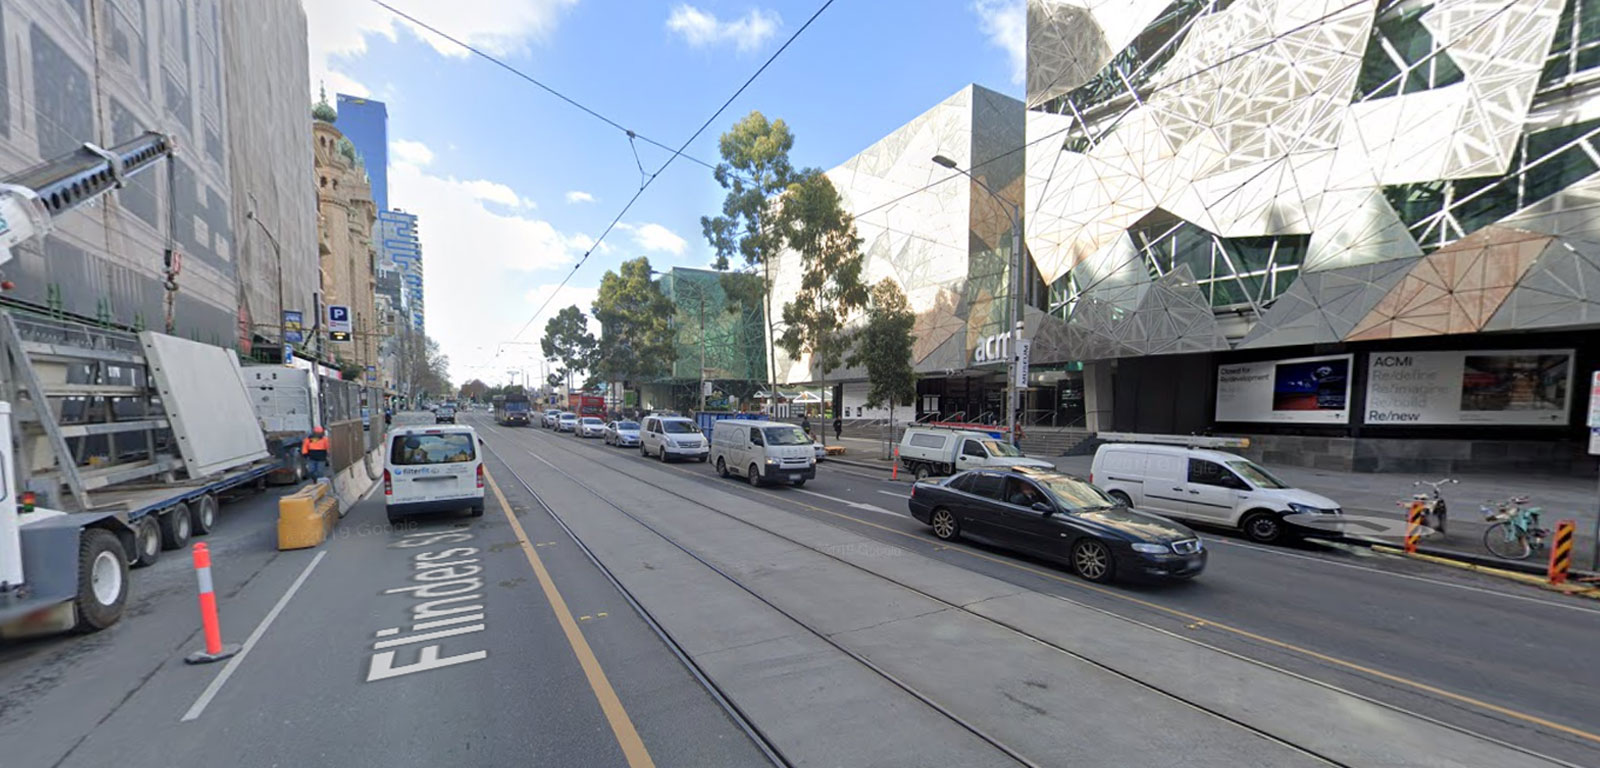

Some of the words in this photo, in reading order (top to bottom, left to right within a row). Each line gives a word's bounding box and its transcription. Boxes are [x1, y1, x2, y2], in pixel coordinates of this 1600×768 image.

[334, 308, 344, 319] P
[1220, 367, 1241, 376] Closed
[1373, 369, 1438, 381] Re/define
[1369, 410, 1421, 421] Re/new
